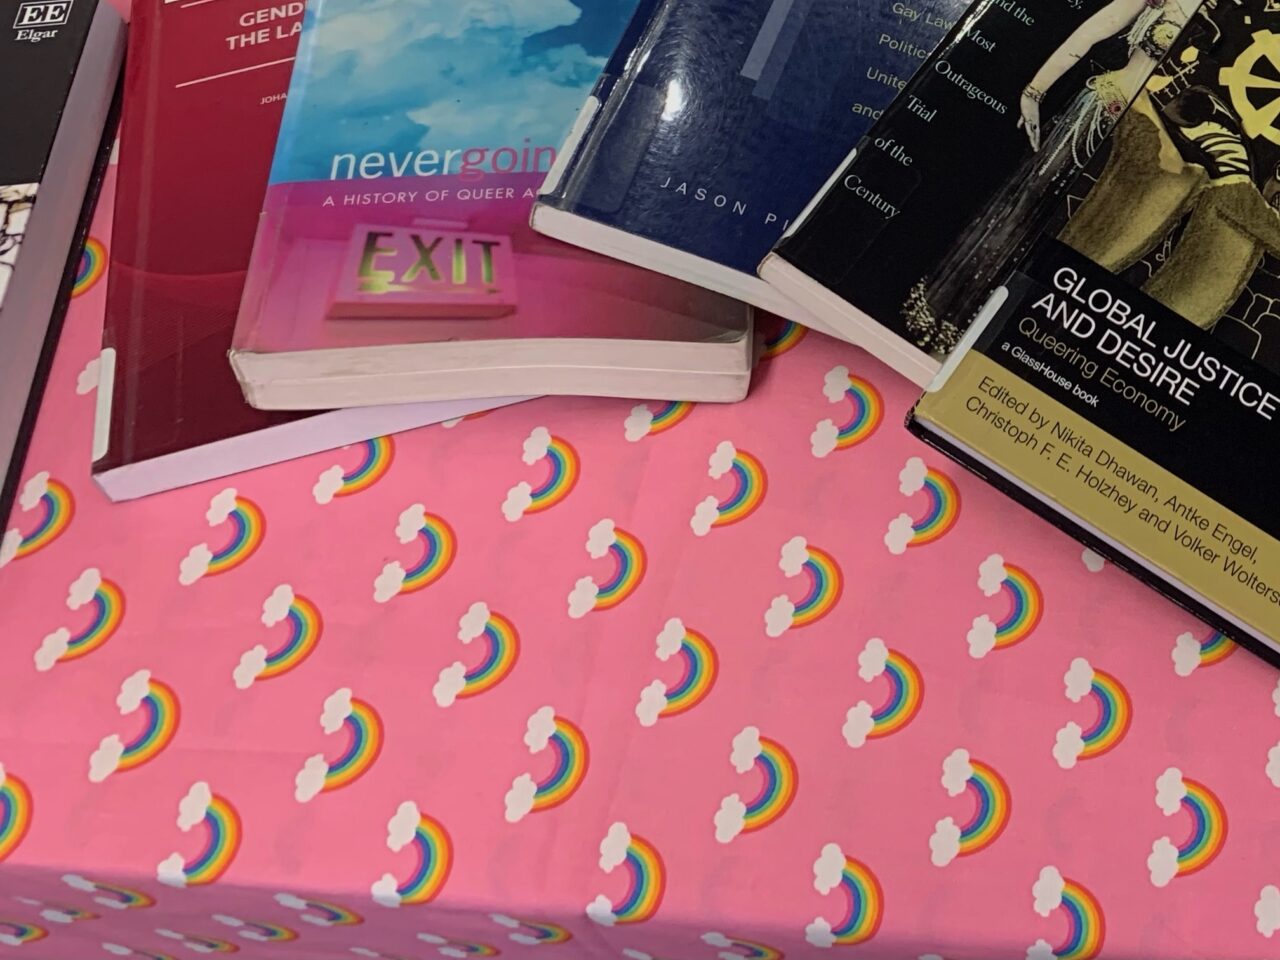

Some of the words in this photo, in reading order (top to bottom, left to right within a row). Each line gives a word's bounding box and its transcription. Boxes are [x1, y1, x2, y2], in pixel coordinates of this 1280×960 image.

[18, 2, 68, 25] EE
[892, 2, 922, 23] Gay
[1013, 3, 1035, 26] the
[15, 28, 58, 42] Elgar
[226, 28, 270, 50] THE
[966, 28, 997, 53] Most
[935, 59, 1008, 116] Outrageous
[851, 101, 884, 121] and
[907, 94, 938, 123] Trial
[874, 137, 896, 151] of
[890, 145, 913, 167] the
[323, 195, 335, 207] A
[343, 191, 418, 206] HISTORY
[425, 190, 450, 202] OF
[457, 187, 515, 200] QUEER
[660, 177, 747, 216] JASON
[844, 174, 901, 220] Century
[358, 230, 502, 294] EXIT
[1053, 266, 1158, 347] GLOBAL
[1031, 293, 1096, 340] AND
[1096, 332, 1201, 406] DESIRE
[1011, 345, 1073, 390] GlassHouse
[1072, 383, 1100, 408] book
[1018, 317, 1099, 379] Queering
[1100, 367, 1187, 433] Economy
[965, 396, 1039, 456] Christoph
[1075, 464, 1137, 514] Holzhey
[1138, 505, 1171, 535] and
[1175, 523, 1221, 566] Volker
[978, 376, 1031, 416] Edited
[1030, 405, 1050, 430] by
[1051, 420, 1094, 459] Nikita
[1095, 450, 1160, 503] Dhawan,
[1163, 493, 1211, 532] Antke
[1211, 523, 1260, 565] Engel,
